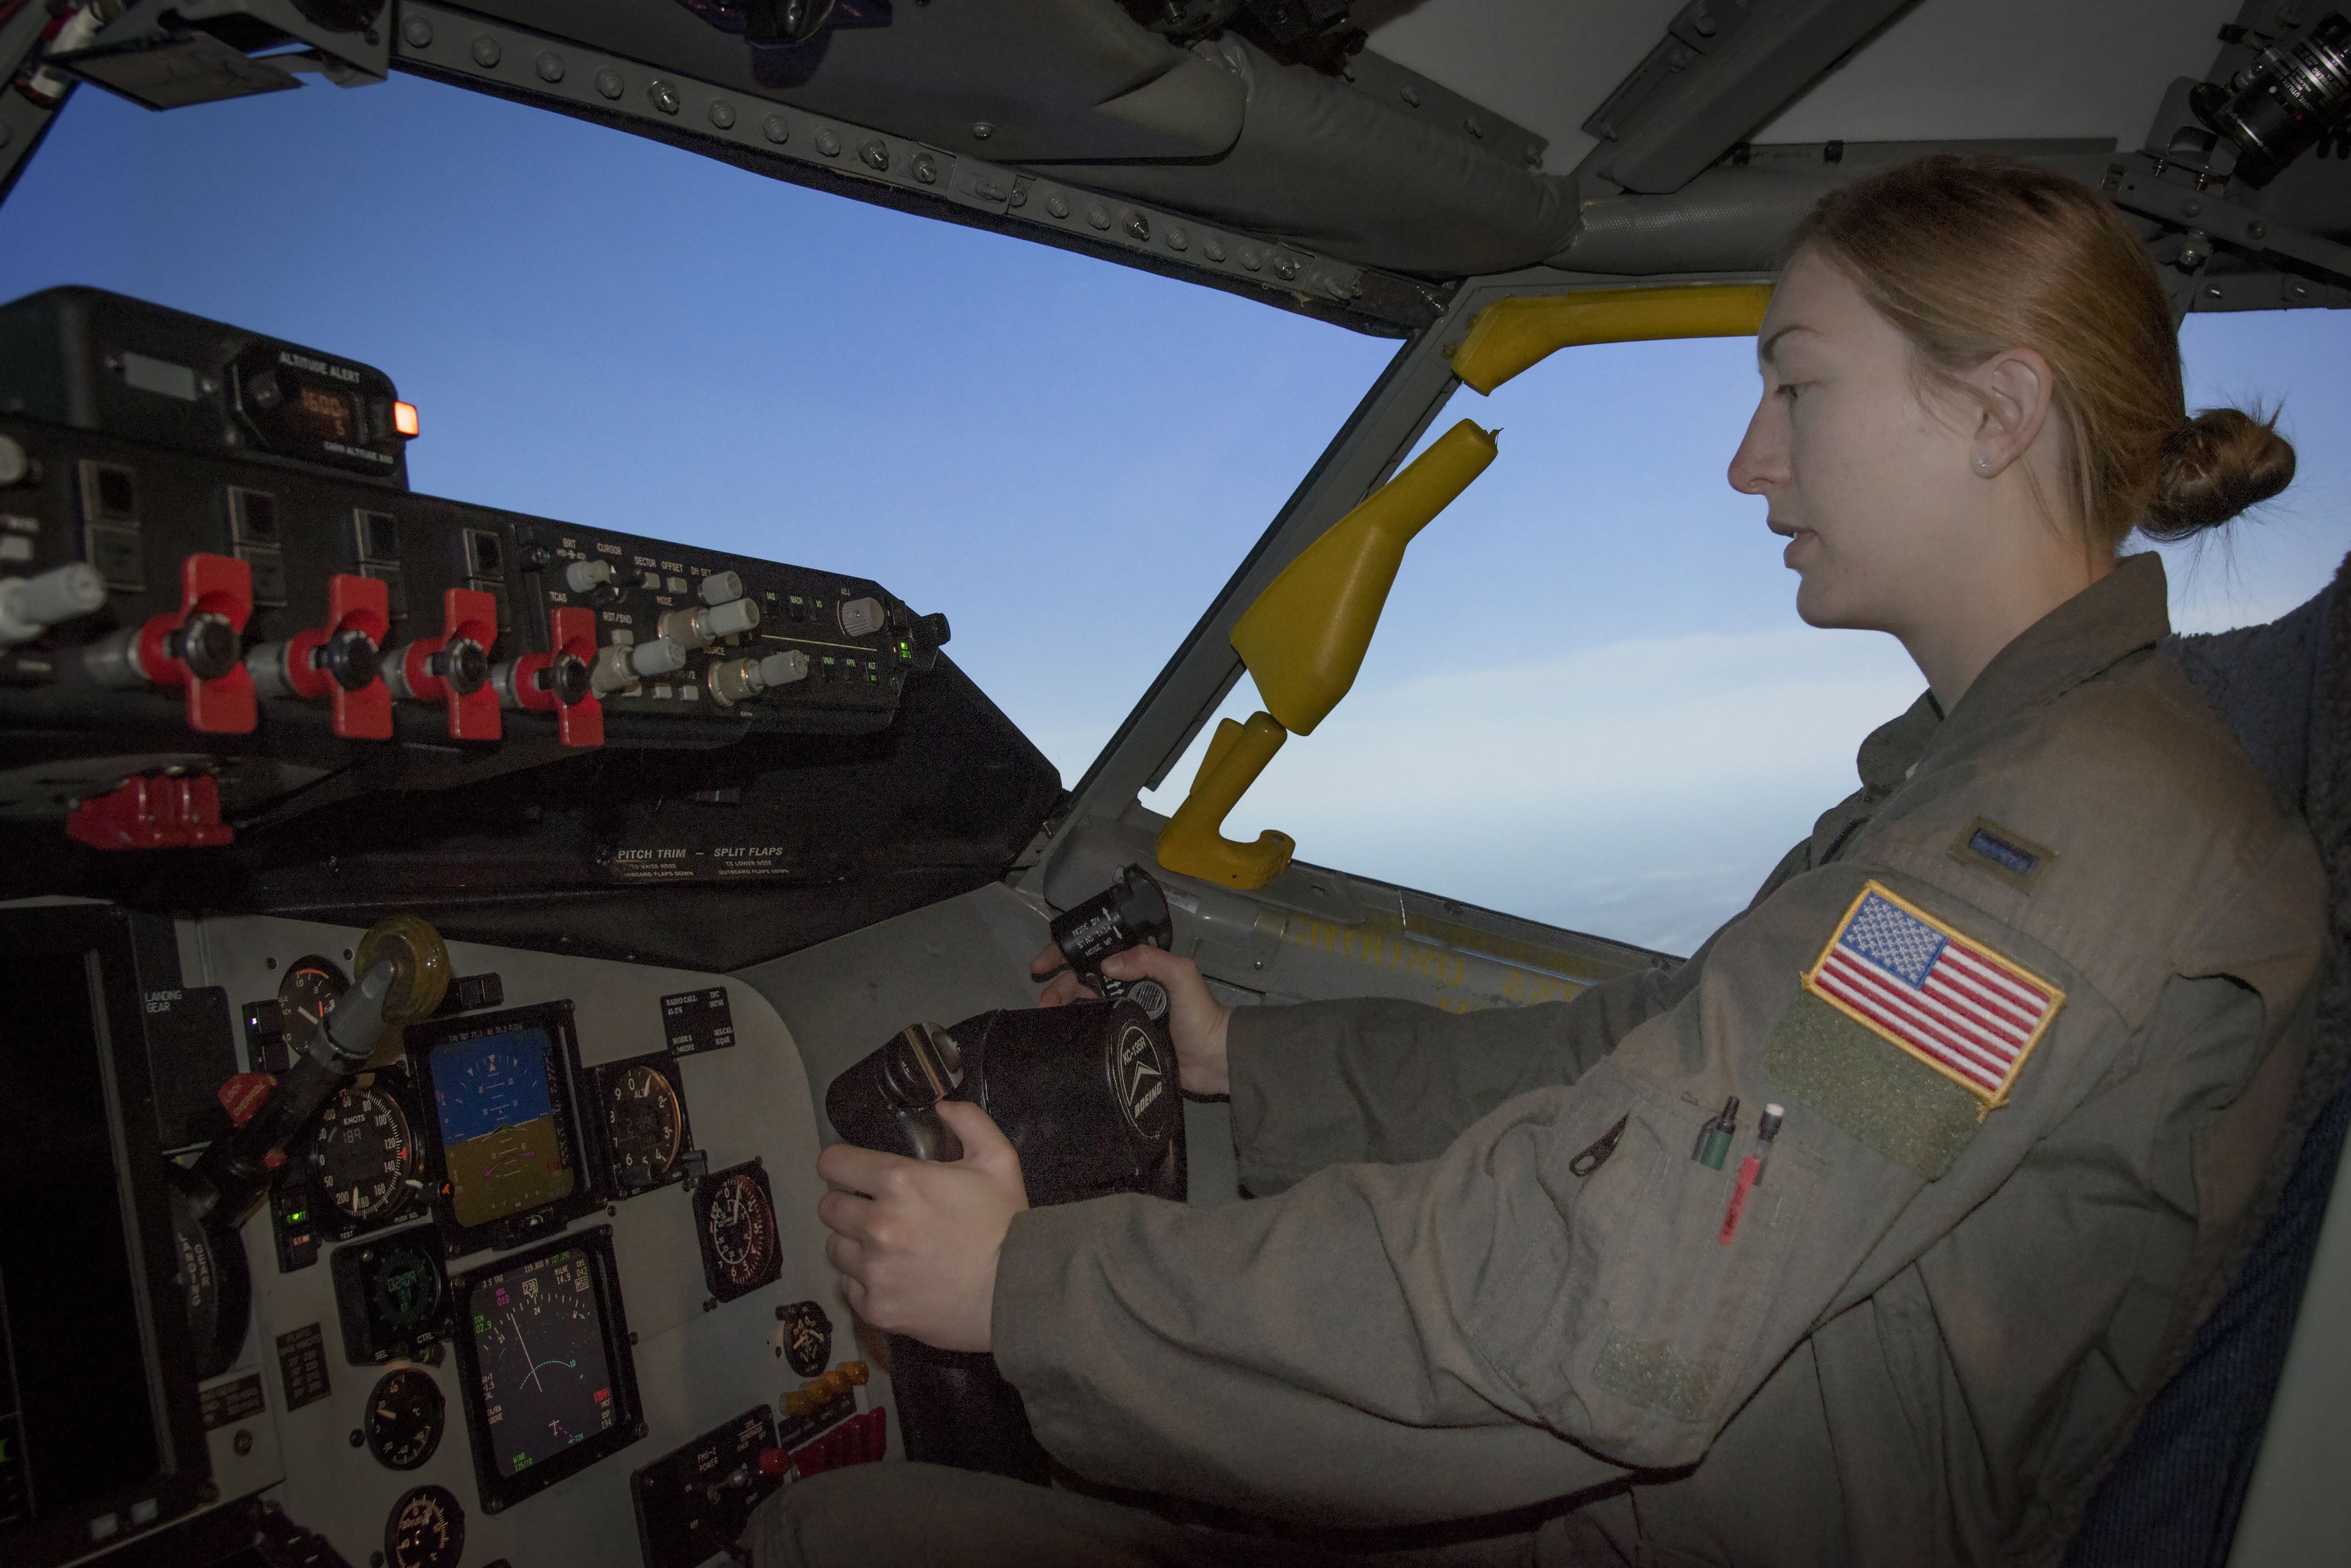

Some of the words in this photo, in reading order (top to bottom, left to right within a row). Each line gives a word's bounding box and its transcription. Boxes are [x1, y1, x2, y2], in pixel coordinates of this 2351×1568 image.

[279, 352, 328, 374] ALTITUDE
[330, 365, 359, 383] ALERT
[562, 537, 575, 549] BRT
[597, 543, 621, 555] CURSOR
[634, 556, 656, 568] SECTOR
[661, 561, 683, 572] OFFSET
[690, 566, 699, 575] DH
[701, 569, 711, 577] SET
[549, 591, 567, 603] TCAS
[767, 592, 775, 601] IAS
[841, 588, 850, 596] ADJ
[657, 596, 673, 606] MODE
[790, 596, 803, 604] MACH
[602, 611, 631, 624] RST/SND
[618, 849, 652, 859] PITCH
[658, 849, 686, 858] TRIM
[714, 848, 745, 857] SPLIT
[749, 847, 783, 856] FLAPS
[1073, 923, 1089, 937] NOSE
[1090, 916, 1101, 926] DN
[1085, 943, 1102, 957] NOSE
[144, 990, 182, 1002] LANDING
[666, 998, 683, 1006] RADIO
[683, 995, 698, 1003] CALL
[146, 1001, 171, 1012] GEAR
[672, 1036, 688, 1044] MODE
[628, 1078, 634, 1090] 0
[615, 1088, 621, 1100] 9
[363, 1100, 372, 1112] 80
[658, 1096, 664, 1108] 2
[344, 1114, 365, 1125] KNOTS
[375, 1114, 387, 1127] 100
[663, 1126, 671, 1139] 3
[384, 1137, 396, 1150] 120
[626, 1153, 632, 1166] 6
[656, 1149, 662, 1160] 4
[384, 1160, 395, 1173] 140
[374, 1183, 386, 1196] 160
[725, 1187, 730, 1198] 0
[336, 1191, 349, 1205] 200
[358, 1196, 369, 1208] 180
[394, 1213, 407, 1223] PUSH
[340, 1231, 353, 1240] TEST
[177, 1232, 201, 1306] LANDING
[194, 1243, 210, 1287] GEAR
[525, 1261, 544, 1273] 119.800
[743, 1261, 749, 1272] 5
[577, 1267, 588, 1277] 042
[731, 1266, 736, 1277] 6
[557, 1273, 571, 1285] 14.9
[576, 1280, 588, 1289] MSG
[524, 1282, 536, 1292] 238
[497, 1295, 509, 1306] 010
[475, 1320, 492, 1334] 02.9
[417, 1332, 434, 1344] CTRL
[375, 1349, 388, 1360] SEL
[570, 1359, 576, 1368] 10
[602, 1418, 612, 1429] 194
[513, 1452, 526, 1464] WIND
[515, 1457, 533, 1473] 135/10
[699, 1456, 719, 1474] POWER
[413, 1507, 419, 1516] 0
